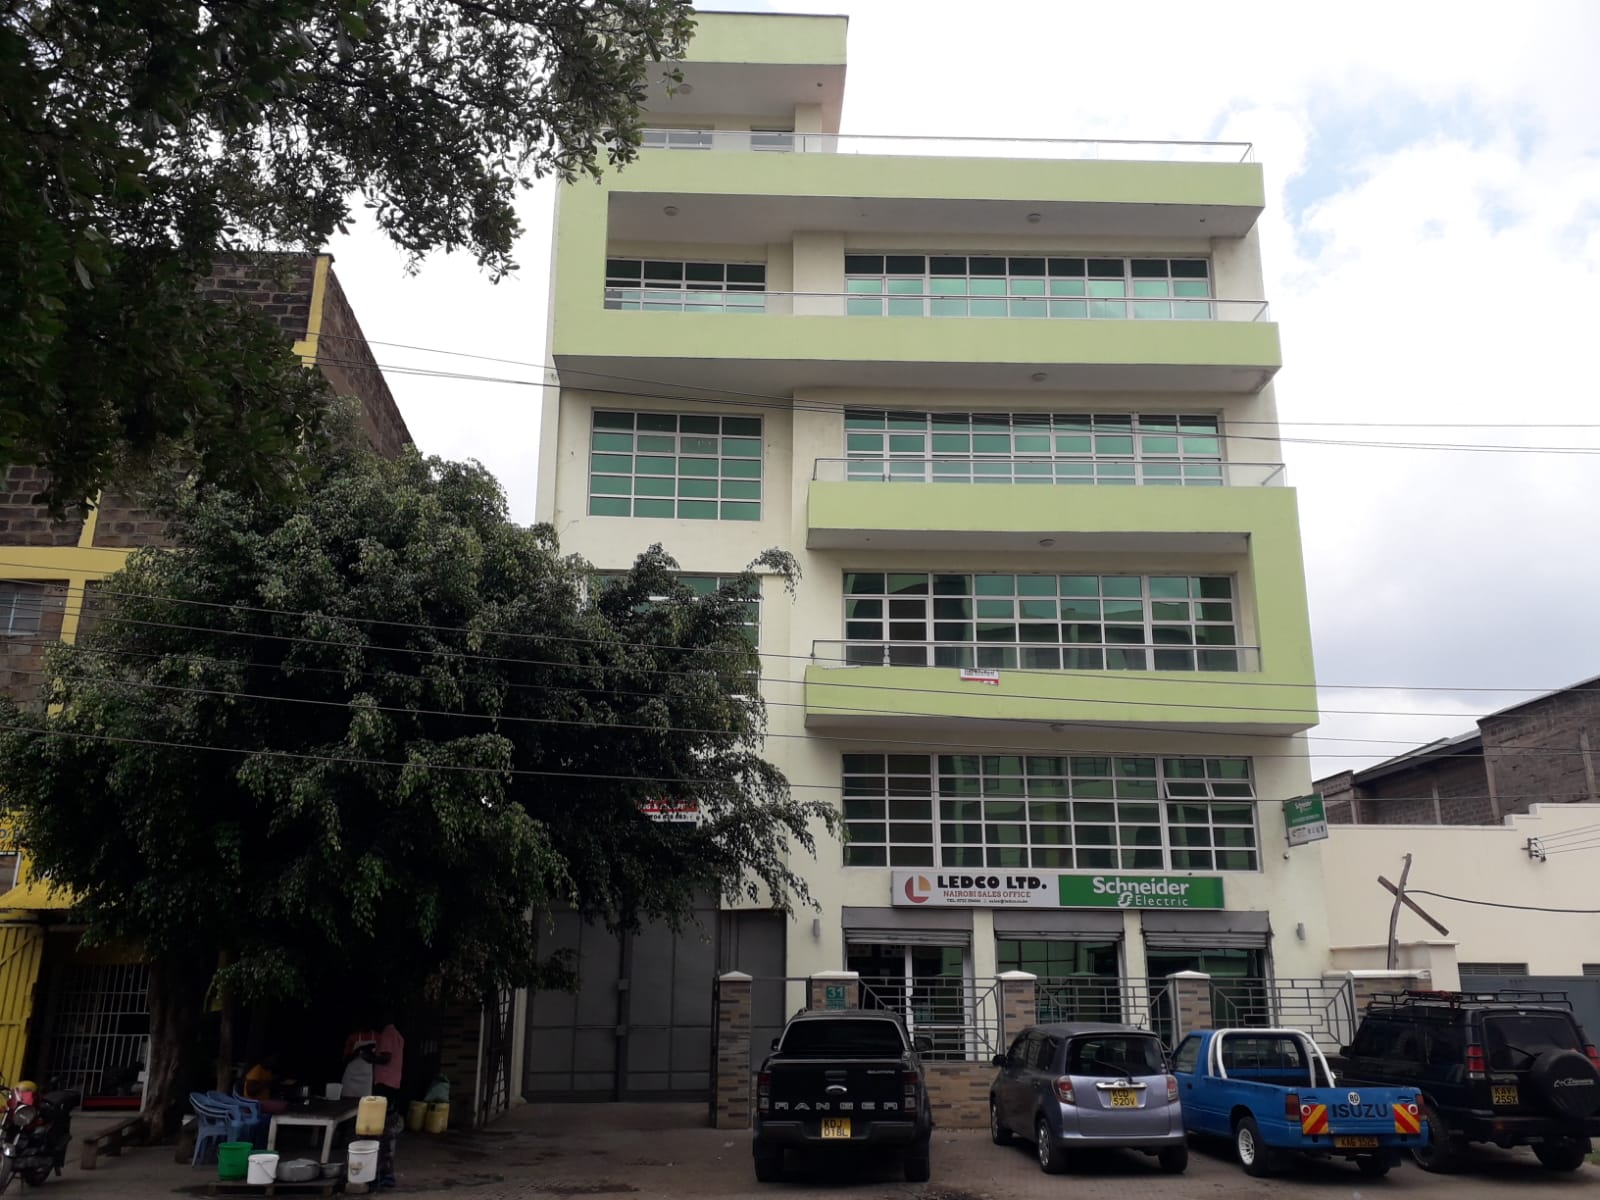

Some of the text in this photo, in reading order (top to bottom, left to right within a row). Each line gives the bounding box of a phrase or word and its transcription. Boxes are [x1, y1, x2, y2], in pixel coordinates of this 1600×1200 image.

[937, 875, 1047, 890] LEDCO LTD.
[1092, 876, 1190, 896] Schneider
[943, 890, 977, 898] NAIROBI
[978, 890, 1002, 898] SALES
[1135, 894, 1189, 907] Electric
[827, 986, 844, 998] 31
[1111, 1089, 1129, 1098] KCD
[774, 1102, 898, 1110] RANGER
[1113, 1097, 1135, 1106] 520V
[1332, 1103, 1389, 1118] ISUZU
[824, 1119, 842, 1128] KDJ
